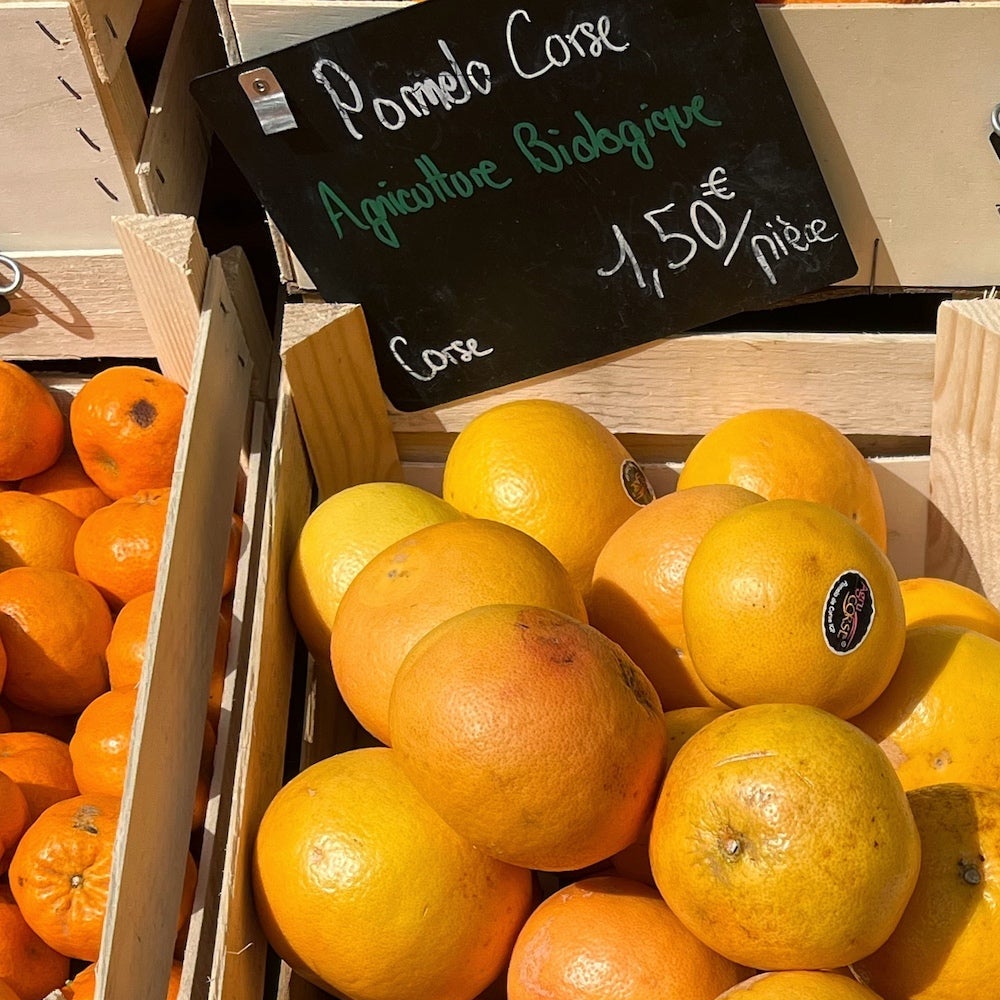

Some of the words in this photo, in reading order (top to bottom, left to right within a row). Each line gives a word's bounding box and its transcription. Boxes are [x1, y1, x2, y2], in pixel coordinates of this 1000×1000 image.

[311, 39, 492, 140] Pomelo
[506, 8, 630, 80] Corse
[316, 154, 513, 250] Agriculture
[513, 94, 723, 173] Biologique
[389, 334, 494, 382] Corse
